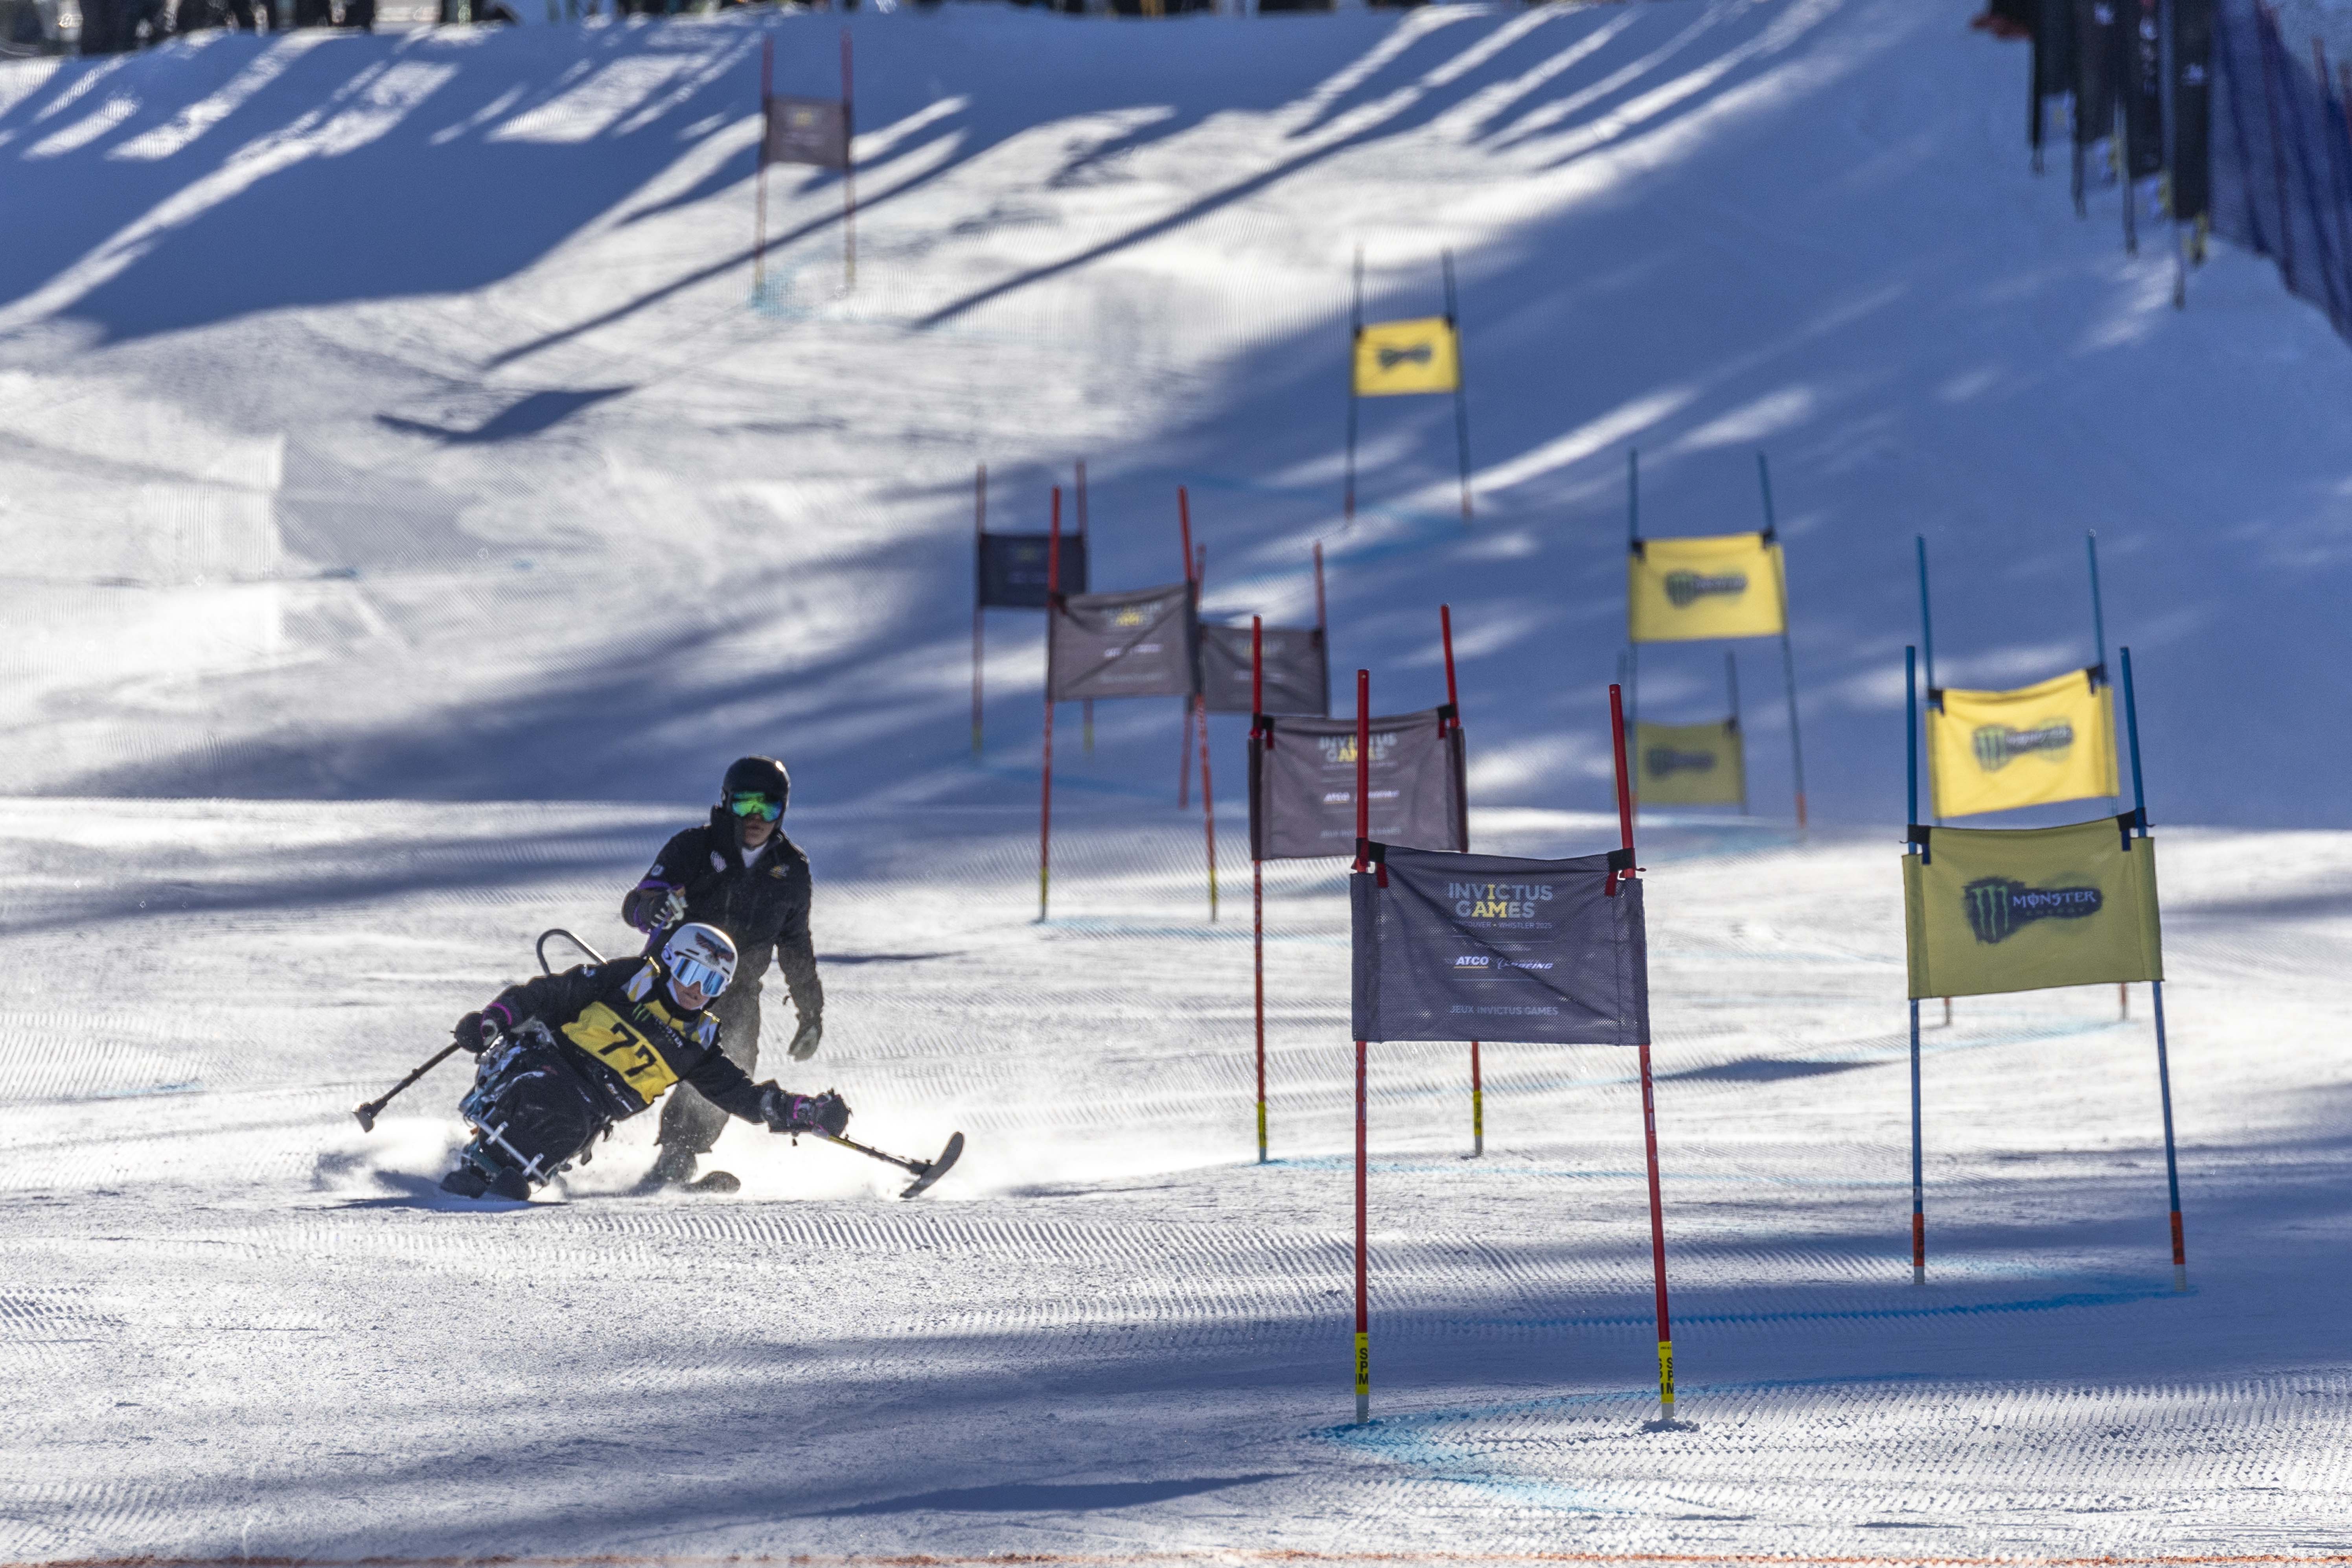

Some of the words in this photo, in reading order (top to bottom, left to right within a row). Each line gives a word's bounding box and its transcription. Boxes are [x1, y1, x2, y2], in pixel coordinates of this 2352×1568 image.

[1448, 883, 1553, 901] INVICTUS
[2012, 891, 2097, 908] MONSTER
[1455, 901, 1535, 918] GAMES
[1455, 956, 1489, 965] ATCO
[1450, 1005, 1474, 1014] JEUX
[1477, 1006, 1522, 1014] INVICTUS
[1525, 1007, 1559, 1015] GAMES
[598, 1022, 657, 1077] 77
[1358, 1347, 1369, 1385] SPM
